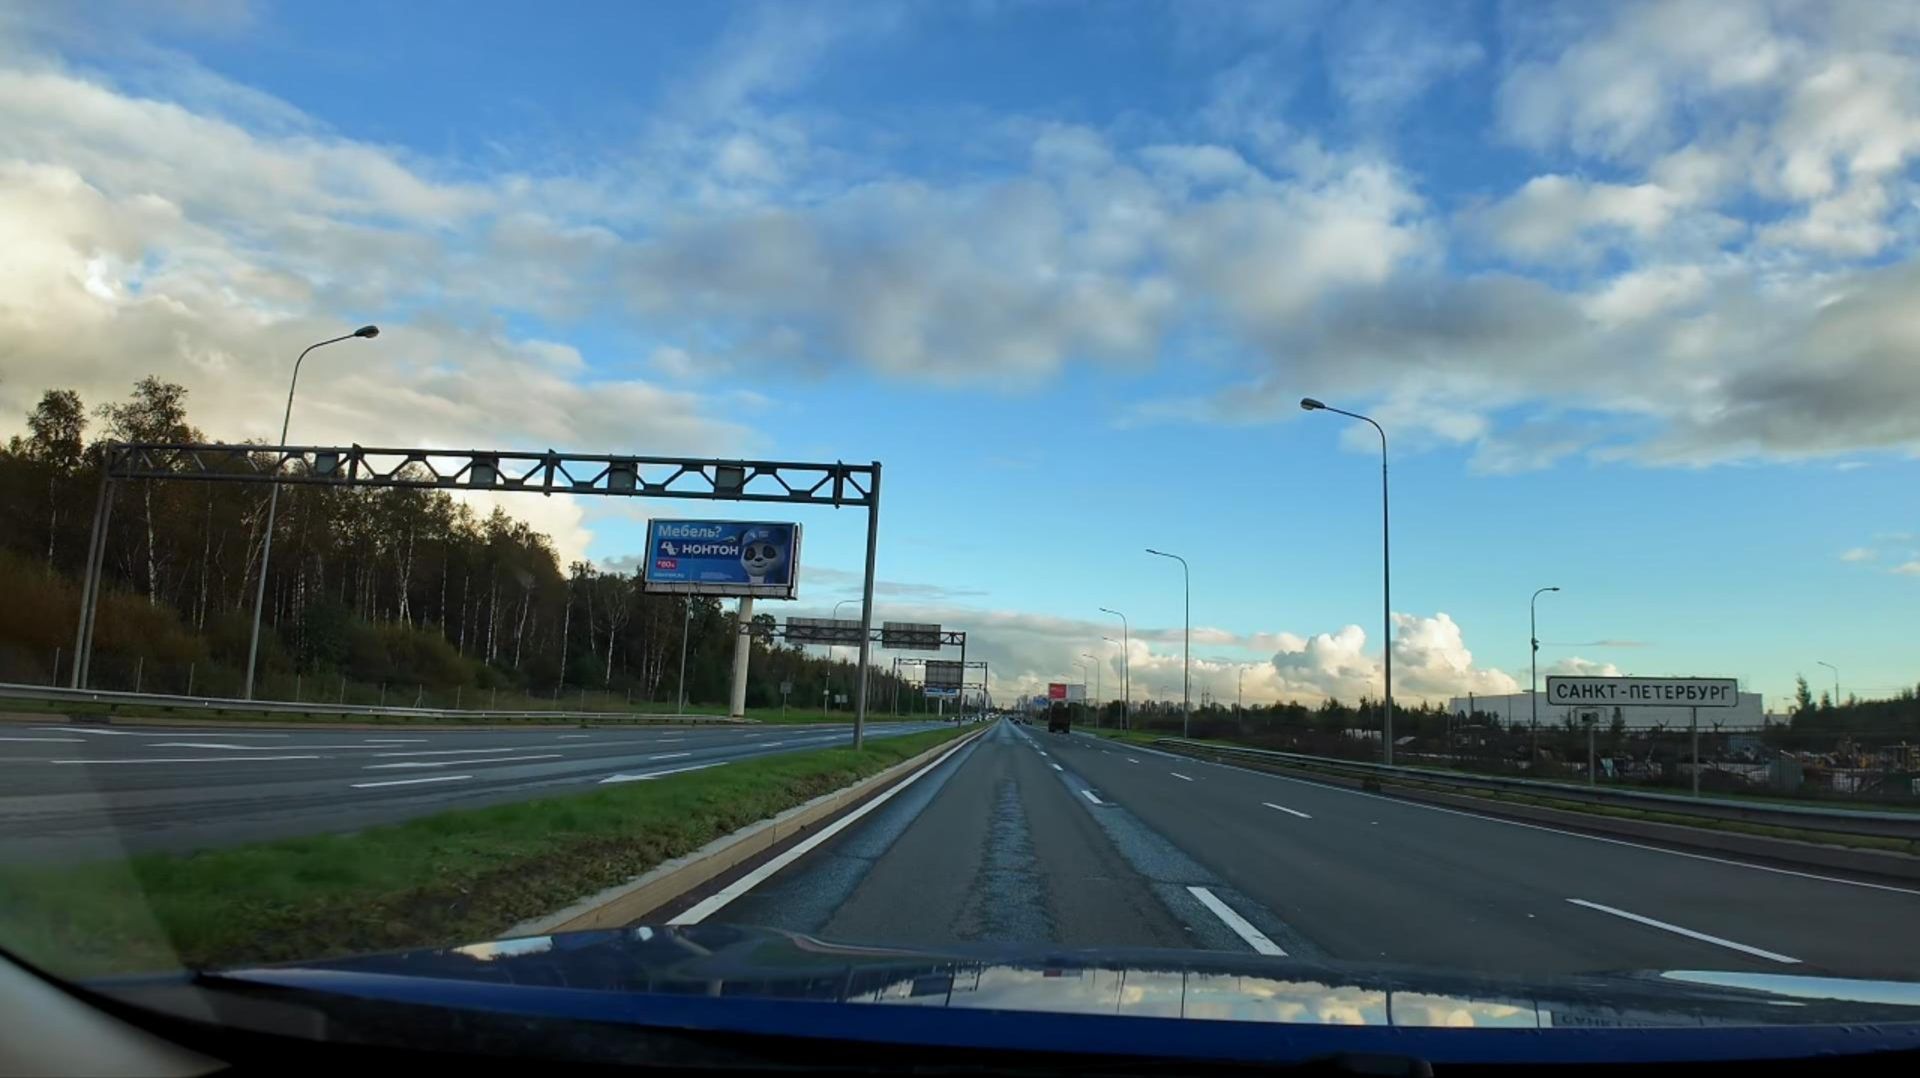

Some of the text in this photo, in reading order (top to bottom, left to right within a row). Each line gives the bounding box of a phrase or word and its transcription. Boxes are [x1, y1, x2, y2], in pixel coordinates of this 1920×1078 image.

[658, 525, 722, 538] Мебель?
[682, 544, 739, 556] НОНТОН
[1556, 684, 1730, 700] САНКТ-ПЕТЕРБУРГ
